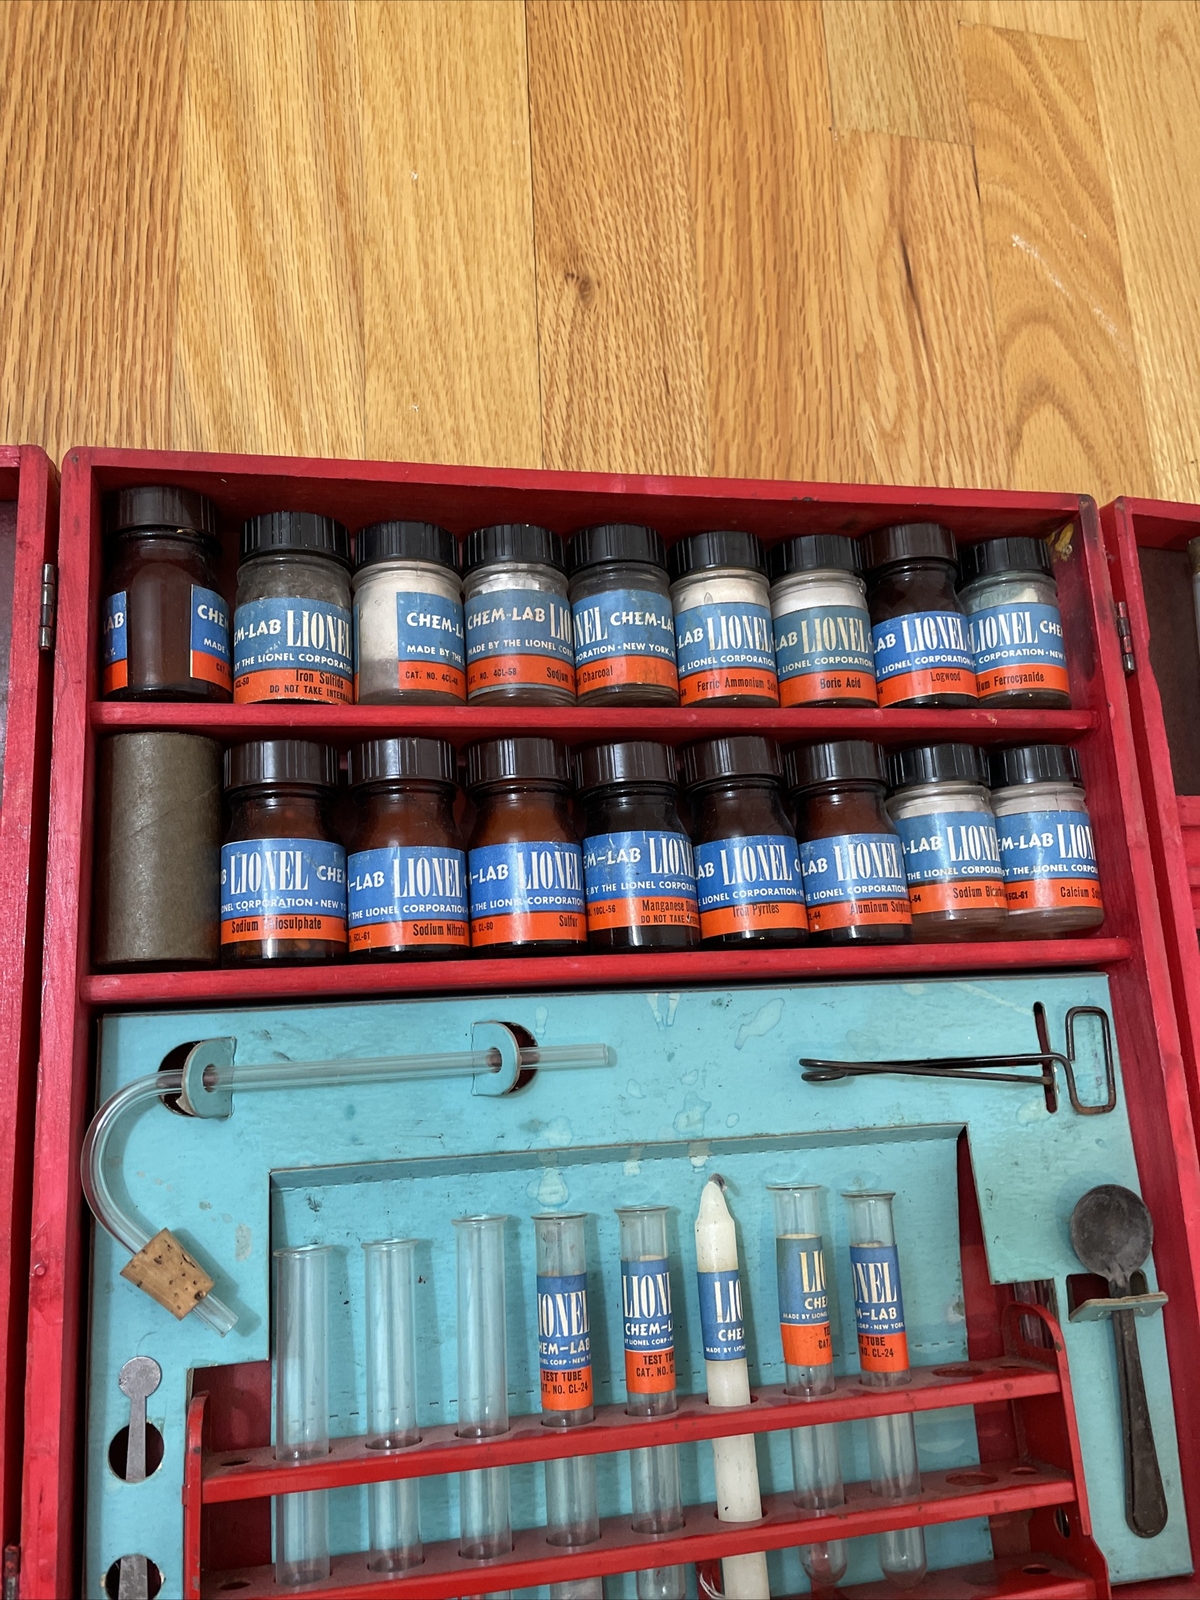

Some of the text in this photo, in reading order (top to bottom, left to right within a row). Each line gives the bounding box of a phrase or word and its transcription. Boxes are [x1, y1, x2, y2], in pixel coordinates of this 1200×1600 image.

[467, 606, 546, 630] CHEM-LAB
[707, 615, 772, 654] LIONEL
[801, 616, 868, 654] LIONEL
[901, 616, 967, 654] LIONEL
[969, 611, 1039, 655] LIONEL
[203, 638, 226, 654] MADE
[488, 641, 499, 649] BY
[504, 639, 521, 647] THE
[525, 639, 556, 650] LIONEL
[623, 642, 645, 650] NEW
[406, 645, 462, 662] MADE BY THE
[979, 648, 1044, 664] CORPORATION
[1049, 649, 1063, 660] NEW
[242, 656, 255, 667] THE
[258, 652, 294, 663] LIONEL
[298, 653, 352, 674] CORPORATIO
[688, 656, 717, 669] LIONEL
[782, 659, 812, 673] LIONEL
[814, 656, 872, 668] CORPORATION
[882, 660, 912, 674] LIONEL
[915, 655, 970, 665] CORPORATION
[295, 669, 314, 683] Iron
[319, 672, 344, 690] Sulfide
[405, 671, 422, 679] CAT.
[426, 672, 438, 681] NO.
[493, 667, 517, 677] 4CL-58
[546, 666, 568, 683] Sodium
[583, 665, 613, 683] Charcoal
[930, 671, 961, 682] Logwood
[994, 672, 1044, 687] Ferrocyanide
[697, 679, 720, 692] Ferric
[725, 677, 764, 689] Ammonium
[820, 677, 861, 689] Boric Acid
[269, 685, 280, 693] DO
[284, 684, 300, 693] NOT
[303, 685, 322, 696] TAKE
[720, 844, 792, 886] LIONEL
[833, 842, 902, 882] LIONEL
[230, 851, 309, 895] LIONEL
[517, 851, 581, 891] LIONEL
[907, 871, 921, 880] THE
[924, 867, 958, 878] LIONEL
[1013, 866, 1029, 875] THE
[1033, 864, 1068, 873] LIONEL
[393, 857, 463, 898] LIONEL
[602, 883, 617, 892] THE
[621, 881, 656, 891] LIONEL
[813, 888, 844, 899] LIONEL
[847, 884, 905, 895] CORPORATION
[953, 886, 982, 899] Sodium
[1060, 886, 1089, 898] Calcium
[702, 893, 730, 905] LIONEL
[733, 887, 797, 899] CORPORATION
[235, 898, 313, 910] CORPORATION
[320, 900, 339, 909] NEW
[475, 902, 487, 911] THE
[642, 900, 684, 912] Manganese
[752, 903, 780, 917] Pyrites
[850, 902, 889, 915] Aluminum
[352, 910, 363, 920] THE
[366, 906, 399, 917] LIONEL
[641, 915, 651, 924] DO
[653, 914, 667, 923] NOT
[670, 914, 685, 923] TAKE
[231, 919, 259, 934] Sodium
[559, 915, 578, 928] Sulfur
[413, 923, 444, 936] Sodium
[783, 1312, 800, 1320] MADE
[801, 1312, 810, 1320] BY
[651, 1337, 667, 1345] CORP
[818, 1339, 831, 1349] CAT.
[865, 1336, 885, 1346] TUBE
[706, 1346, 721, 1354] MADE
[872, 1348, 894, 1357] CL-24
[572, 1356, 586, 1364] NEW
[643, 1354, 662, 1365] TEST
[543, 1370, 582, 1382] TEST TUBE
[636, 1367, 654, 1377] CAT.
[657, 1366, 669, 1377] NO.
[552, 1384, 566, 1394] NO.
[568, 1381, 589, 1394] CL-24
